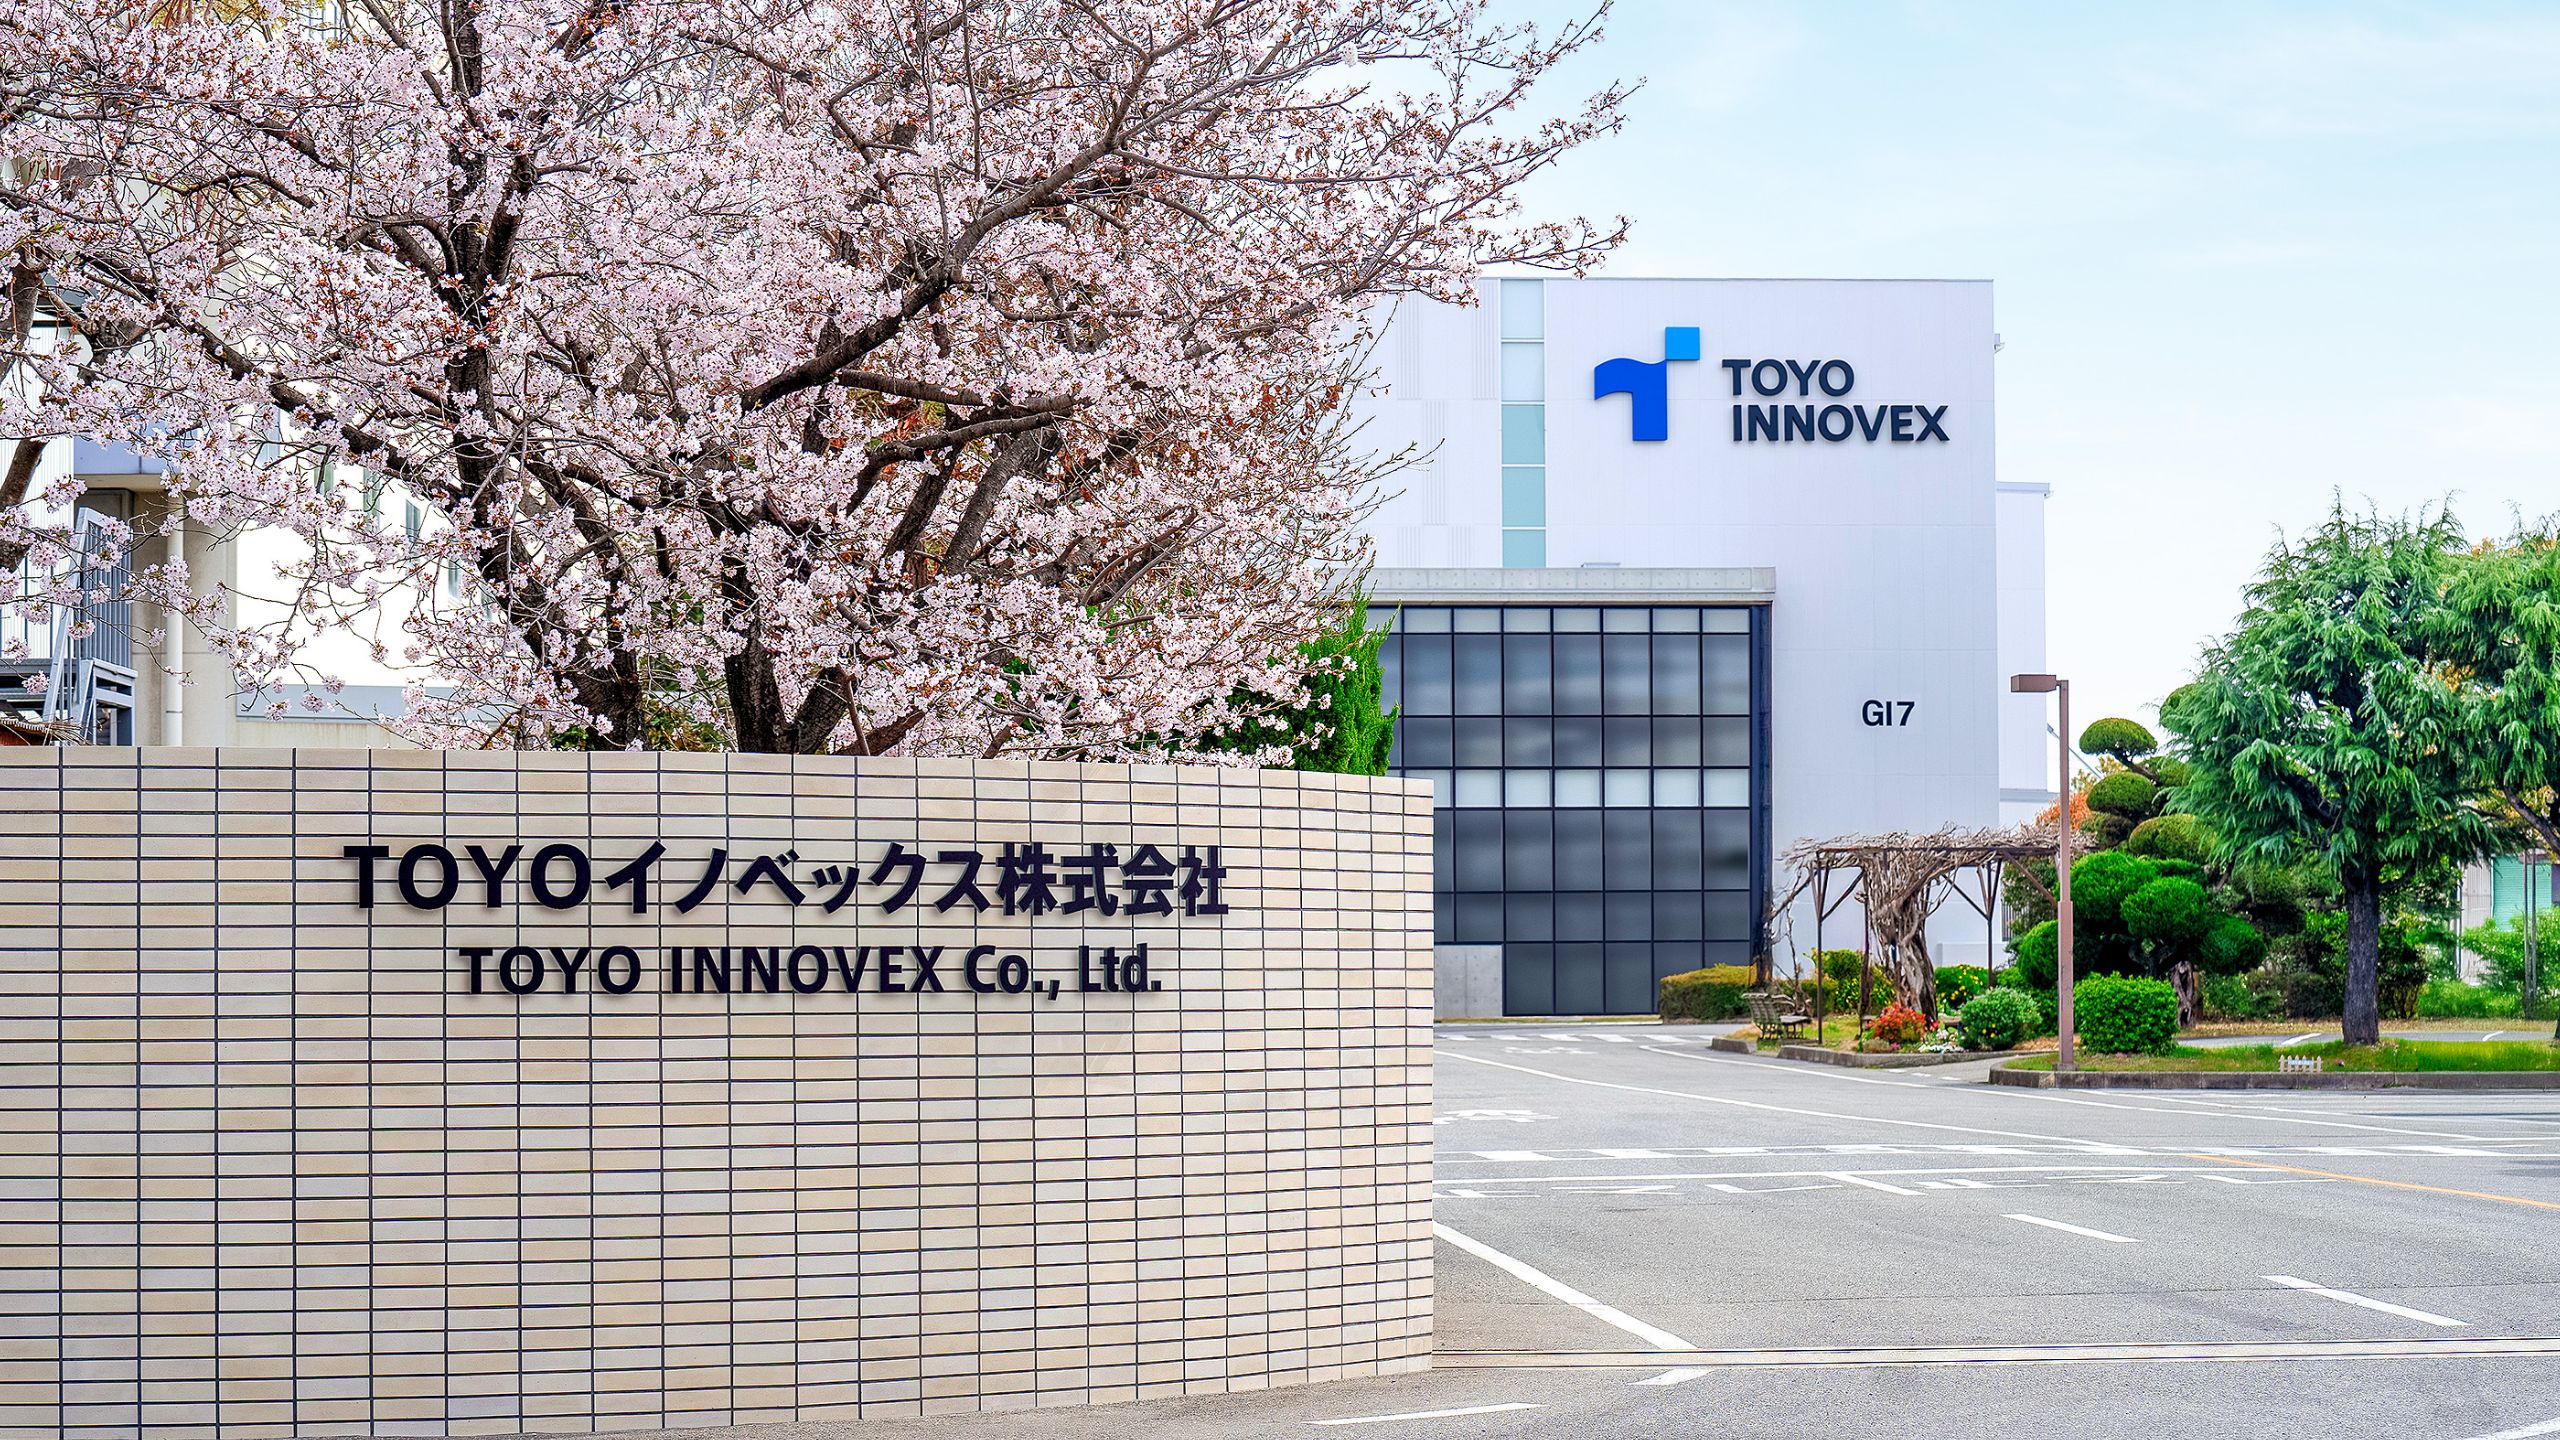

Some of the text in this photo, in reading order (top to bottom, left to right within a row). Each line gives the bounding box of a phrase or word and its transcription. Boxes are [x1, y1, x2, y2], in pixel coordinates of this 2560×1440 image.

[1722, 359, 1855, 397] TOYO
[1733, 404, 1950, 442] INNOVEX
[343, 840, 1229, 917] TOYOイノベックス株式会社
[459, 942, 1162, 1001] TOYO INNOVEX Co., Ltd.
